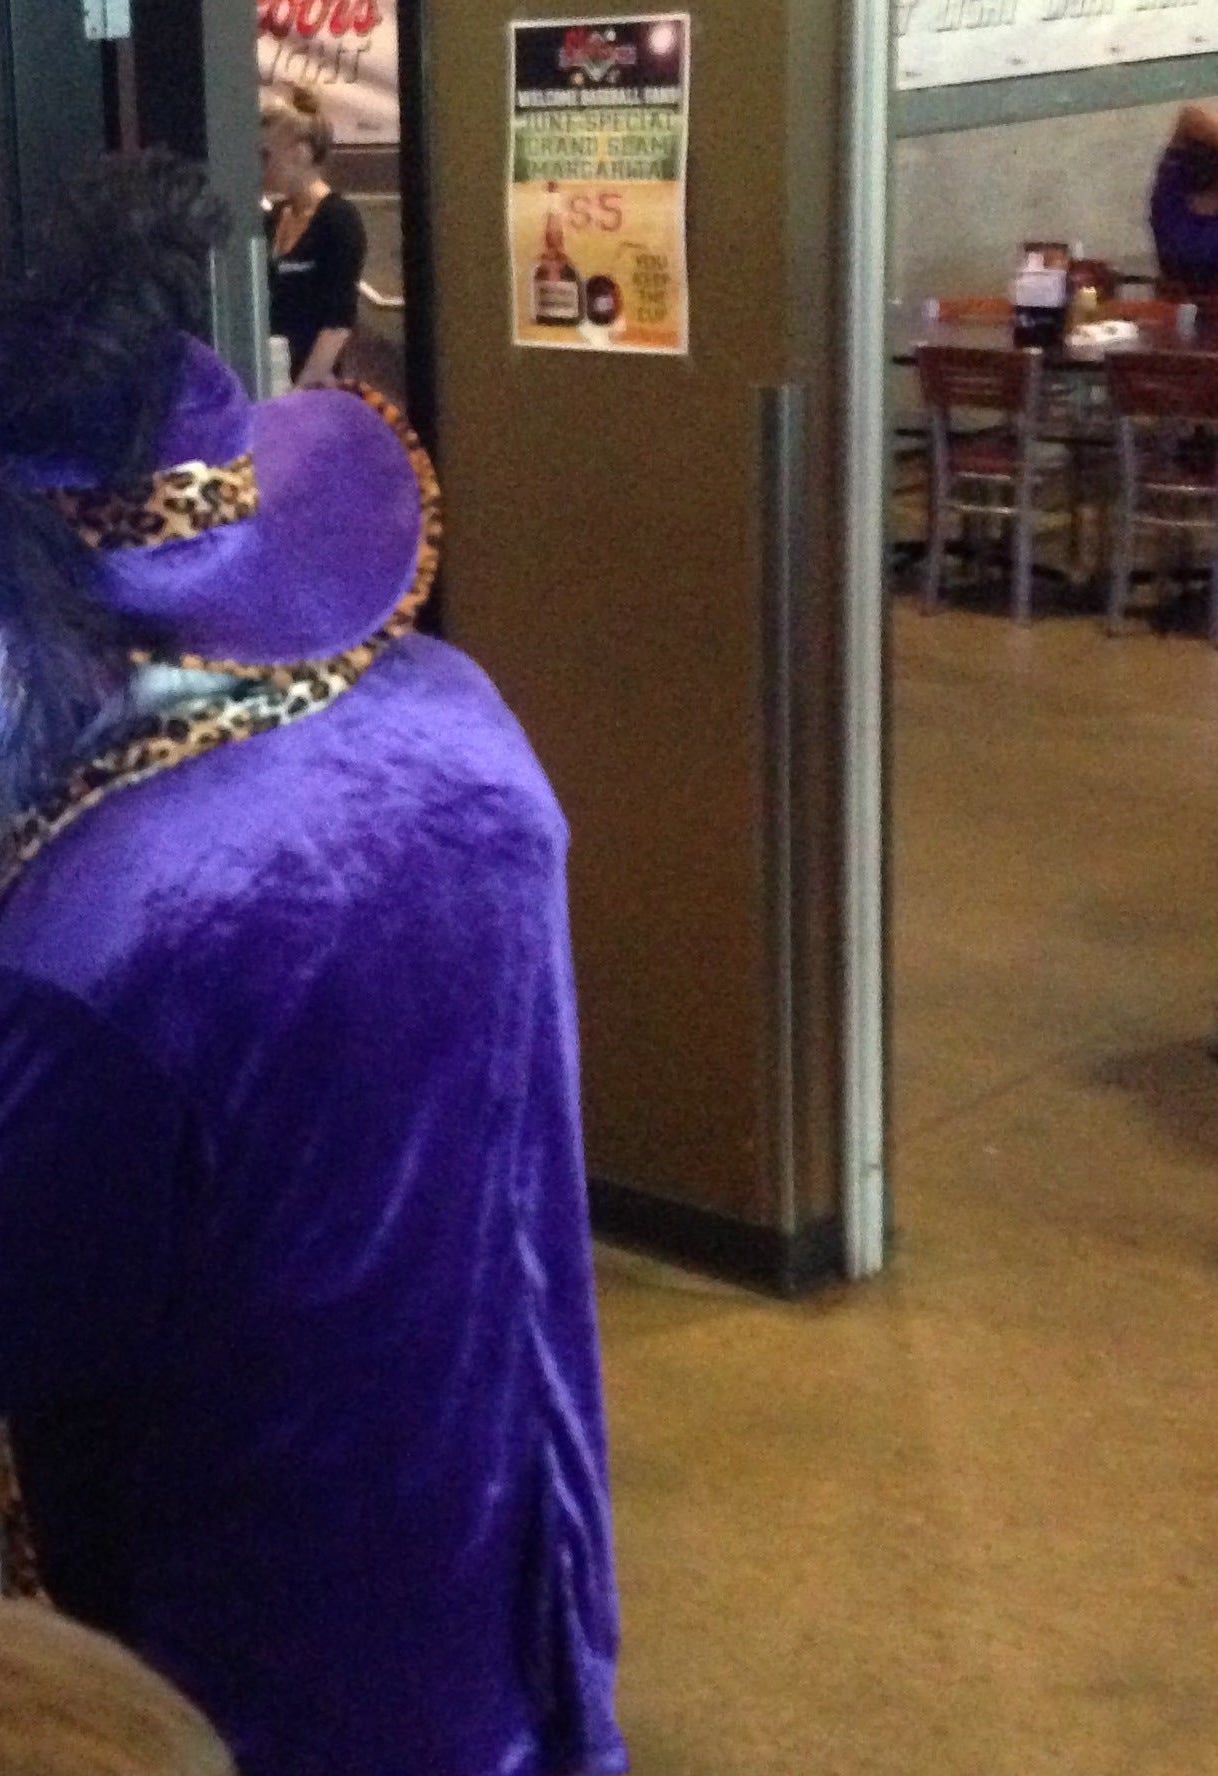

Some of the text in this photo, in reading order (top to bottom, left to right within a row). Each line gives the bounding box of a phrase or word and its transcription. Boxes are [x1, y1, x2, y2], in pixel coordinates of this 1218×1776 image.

[528, 110, 675, 133] JUNE SPECIAL
[527, 136, 598, 155] GRAND
[530, 160, 662, 179] MARGARITA
